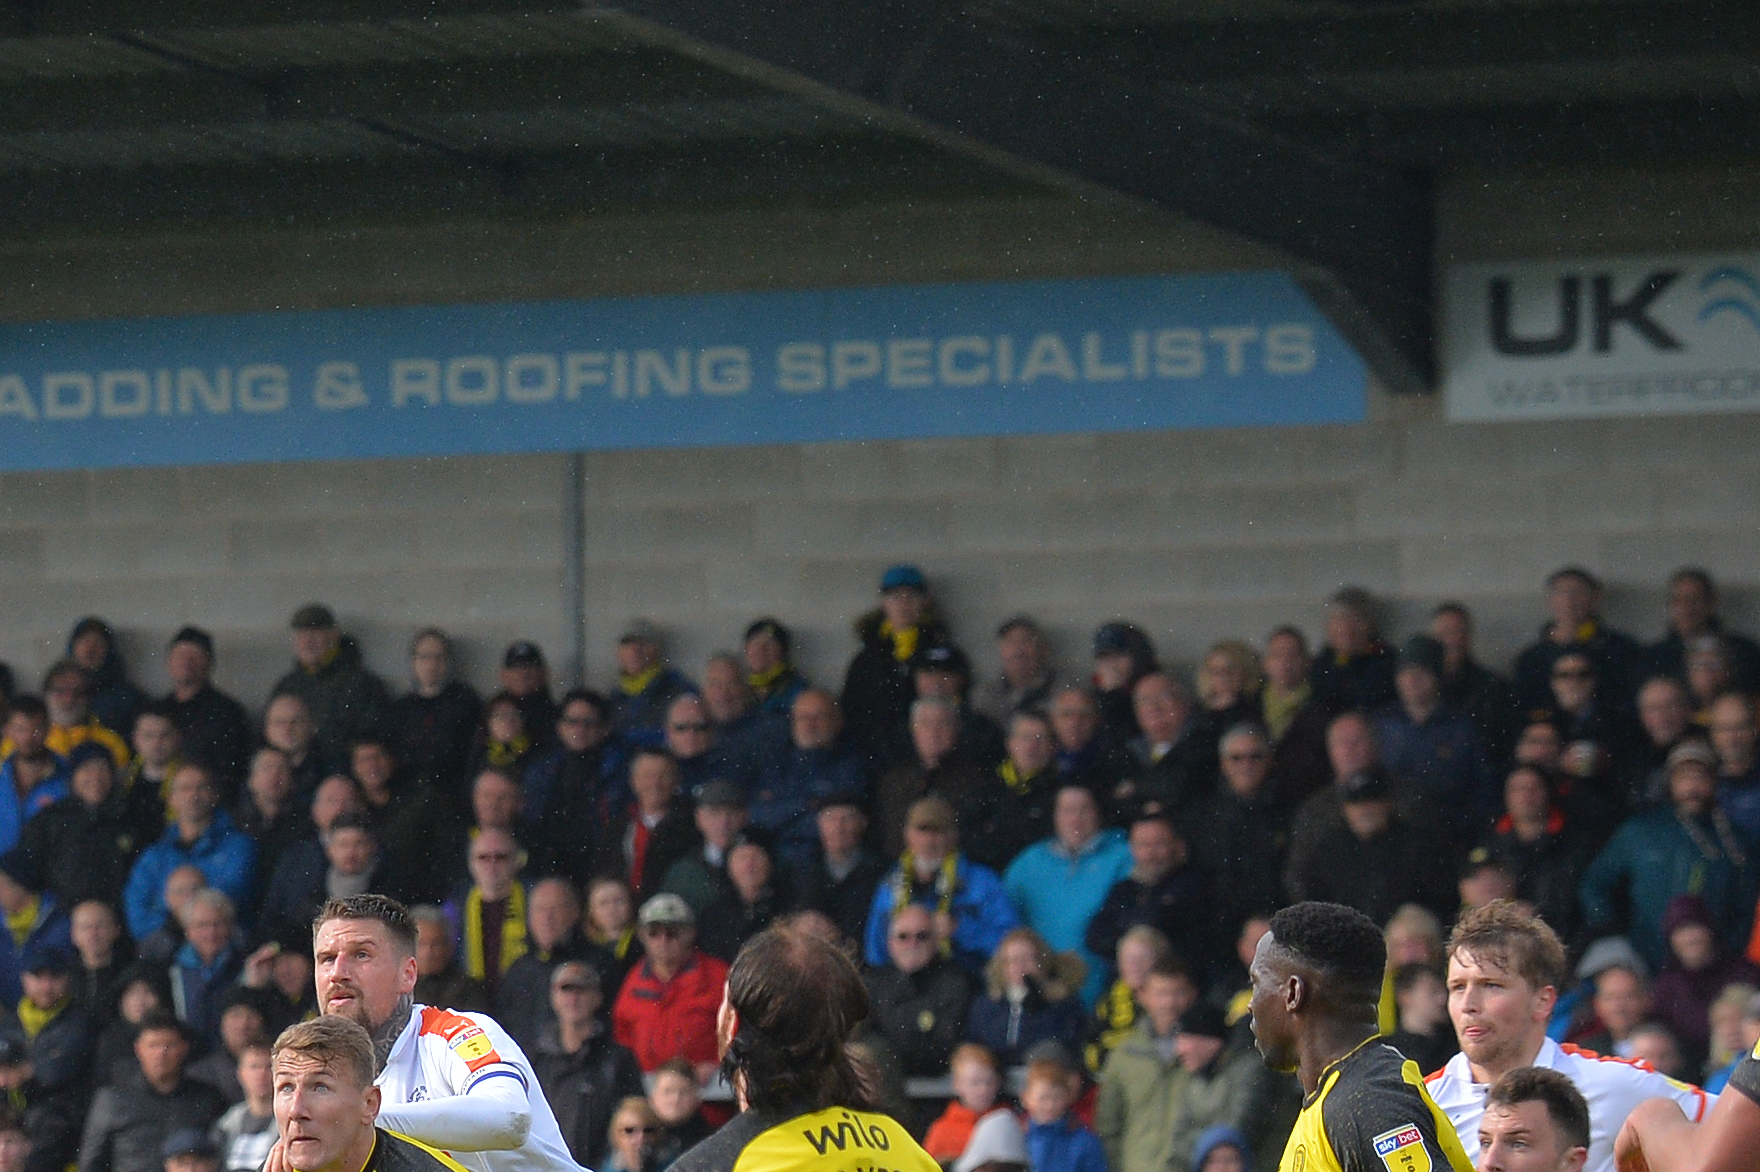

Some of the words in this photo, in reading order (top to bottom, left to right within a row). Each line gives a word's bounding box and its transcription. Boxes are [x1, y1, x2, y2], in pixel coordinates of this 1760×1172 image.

[1489, 268, 1686, 357] UK
[313, 360, 371, 410] &
[390, 345, 752, 406] ROOFING
[775, 324, 1315, 391] SPECIALISTS
[803, 1111, 891, 1156] wilo
[1378, 1137, 1398, 1153] sky
[1398, 1130, 1419, 1144] bet
